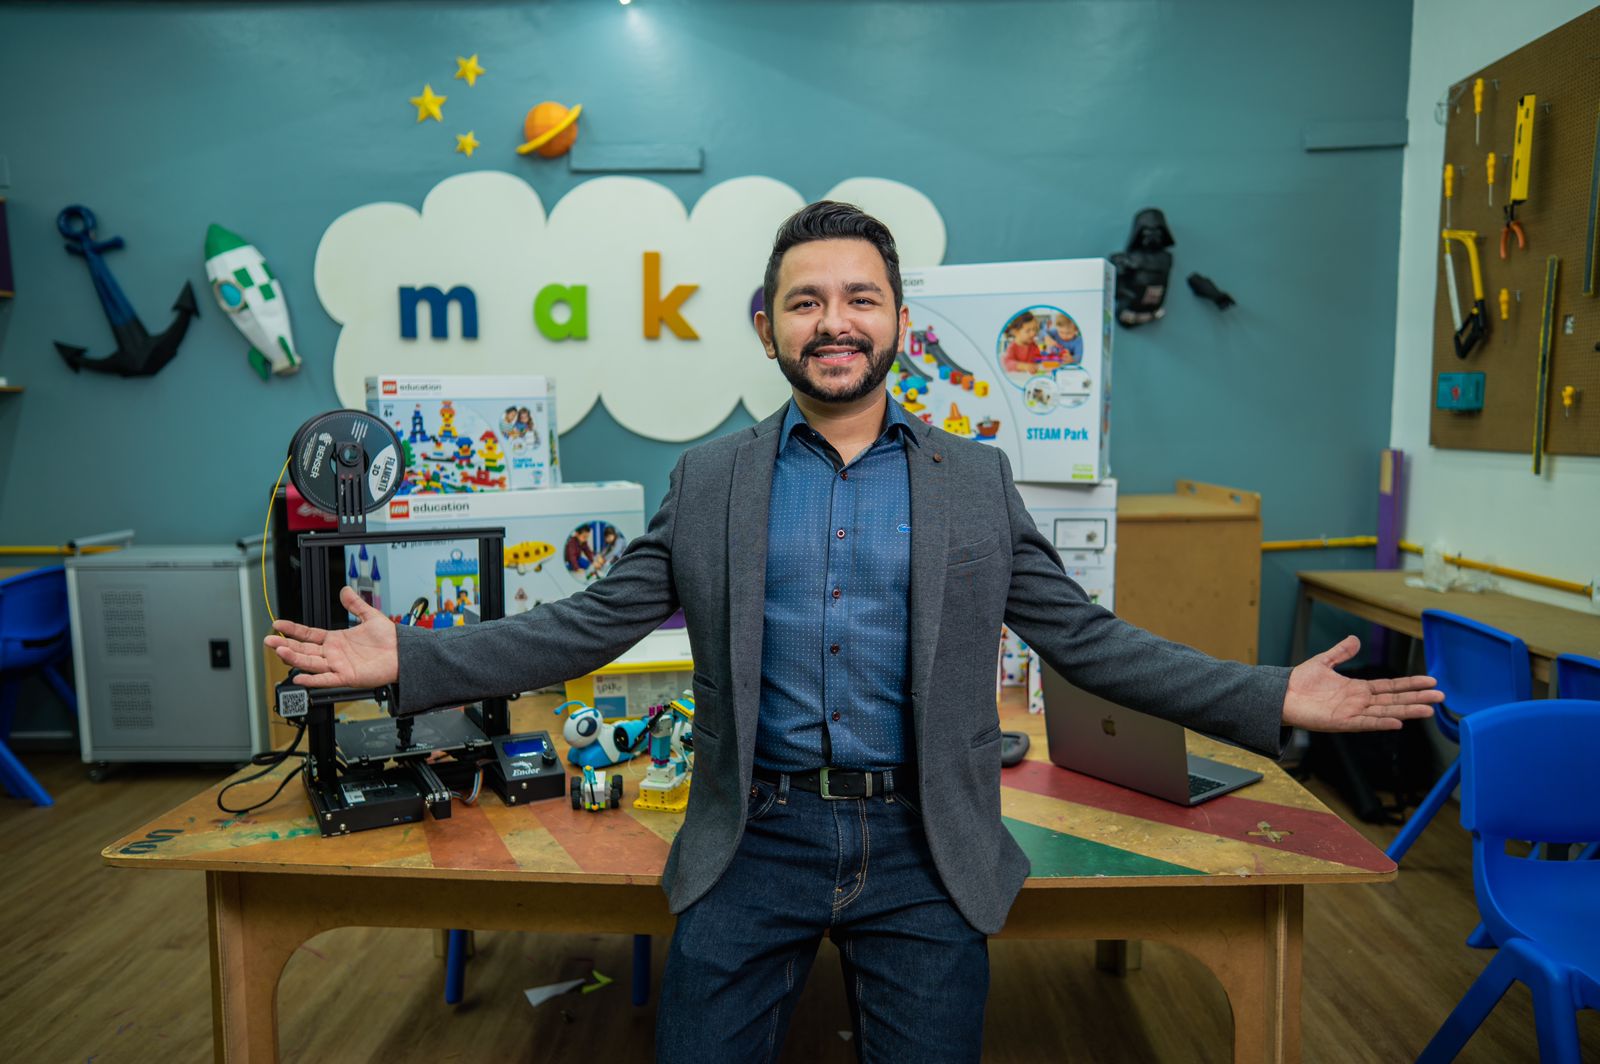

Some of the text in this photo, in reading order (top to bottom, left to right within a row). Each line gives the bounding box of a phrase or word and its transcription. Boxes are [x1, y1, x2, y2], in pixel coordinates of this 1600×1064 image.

[400, 383, 443, 392] education
[1026, 427, 1089, 441] STEAM Park
[309, 444, 326, 479] BENSER
[371, 464, 381, 476] 3D
[412, 502, 470, 513] education
[512, 767, 541, 777] Ender
